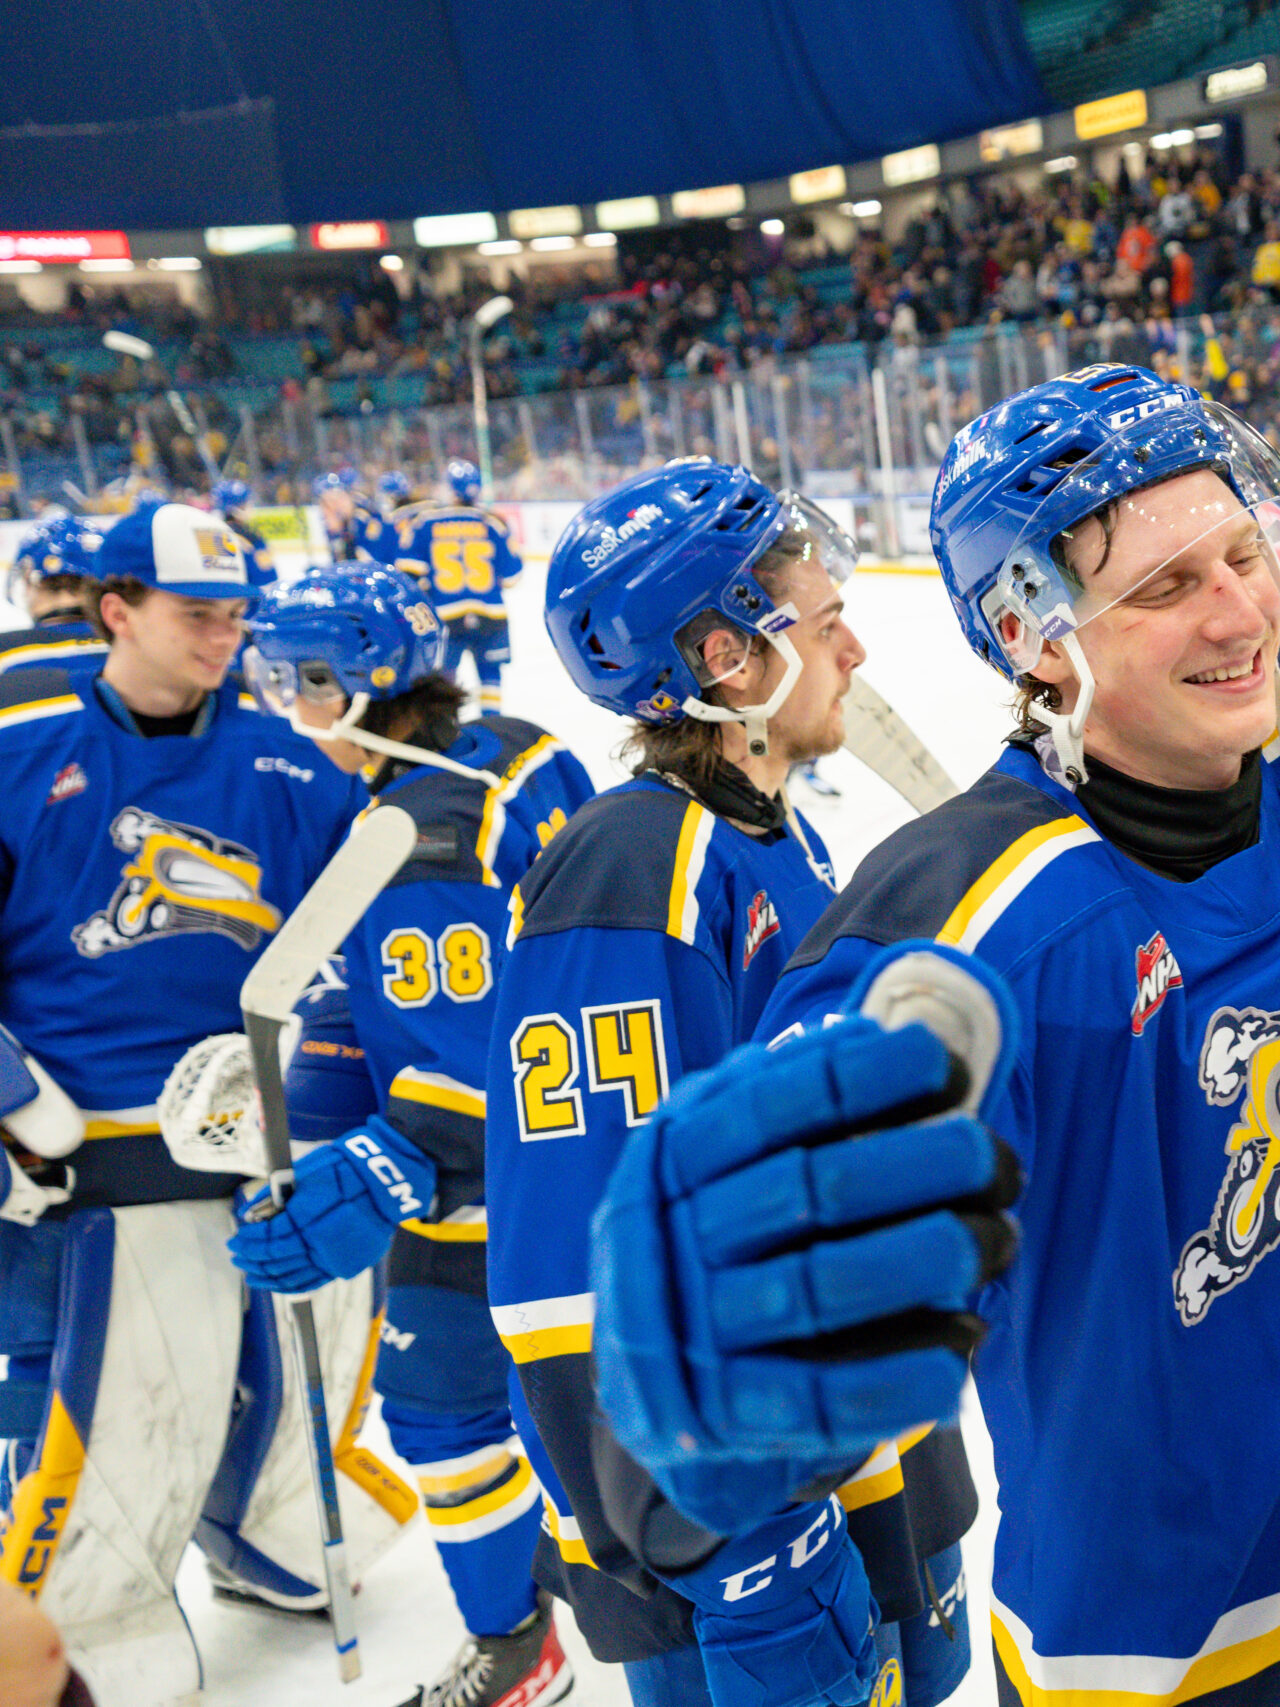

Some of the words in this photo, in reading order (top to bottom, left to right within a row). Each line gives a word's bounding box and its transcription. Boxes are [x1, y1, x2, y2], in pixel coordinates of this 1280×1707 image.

[1107, 393, 1184, 430] CCM
[430, 540, 494, 593] 55
[381, 922, 494, 1009] 38
[510, 999, 670, 1143] 24
[344, 1134, 424, 1214] CCM
[17, 1496, 67, 1600] CM
